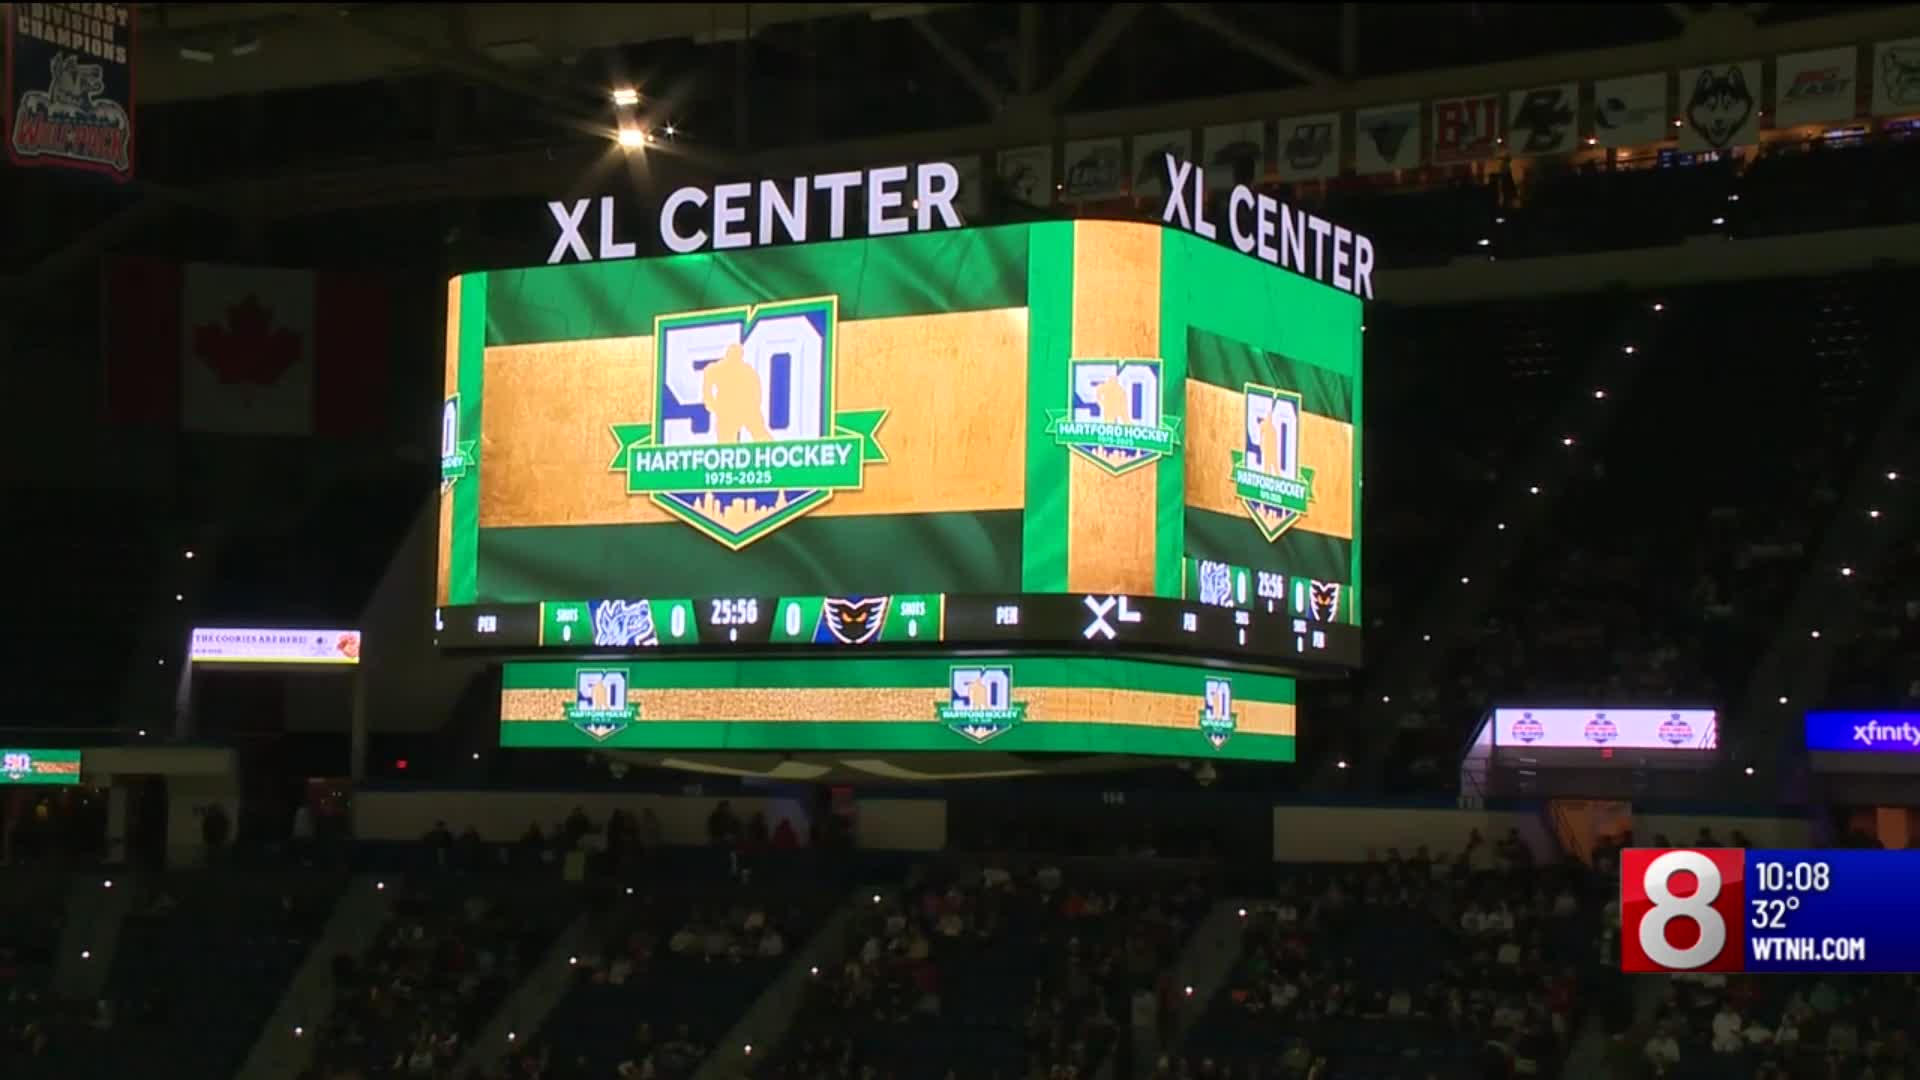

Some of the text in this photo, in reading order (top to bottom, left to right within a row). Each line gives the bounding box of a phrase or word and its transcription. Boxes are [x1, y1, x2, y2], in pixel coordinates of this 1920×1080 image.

[17, 15, 127, 64] CHAMPIONS
[547, 162, 962, 264] XL CENTER
[1163, 152, 1374, 300] XL CENTER
[664, 315, 823, 446] 50
[1073, 364, 1158, 426] 50
[1059, 424, 1169, 443] HARTFORD HOCKEY
[1246, 393, 1297, 480] 50
[636, 443, 852, 472] HARTFORD HOCKEY
[705, 471, 772, 485] 1975-2025
[671, 604, 686, 637] 0
[711, 599, 758, 624] 25:56
[785, 602, 801, 636] 0
[1083, 595, 1141, 639] XL
[579, 672, 625, 710] 50
[953, 669, 1008, 710] 50
[1853, 719, 1920, 747] xfinity
